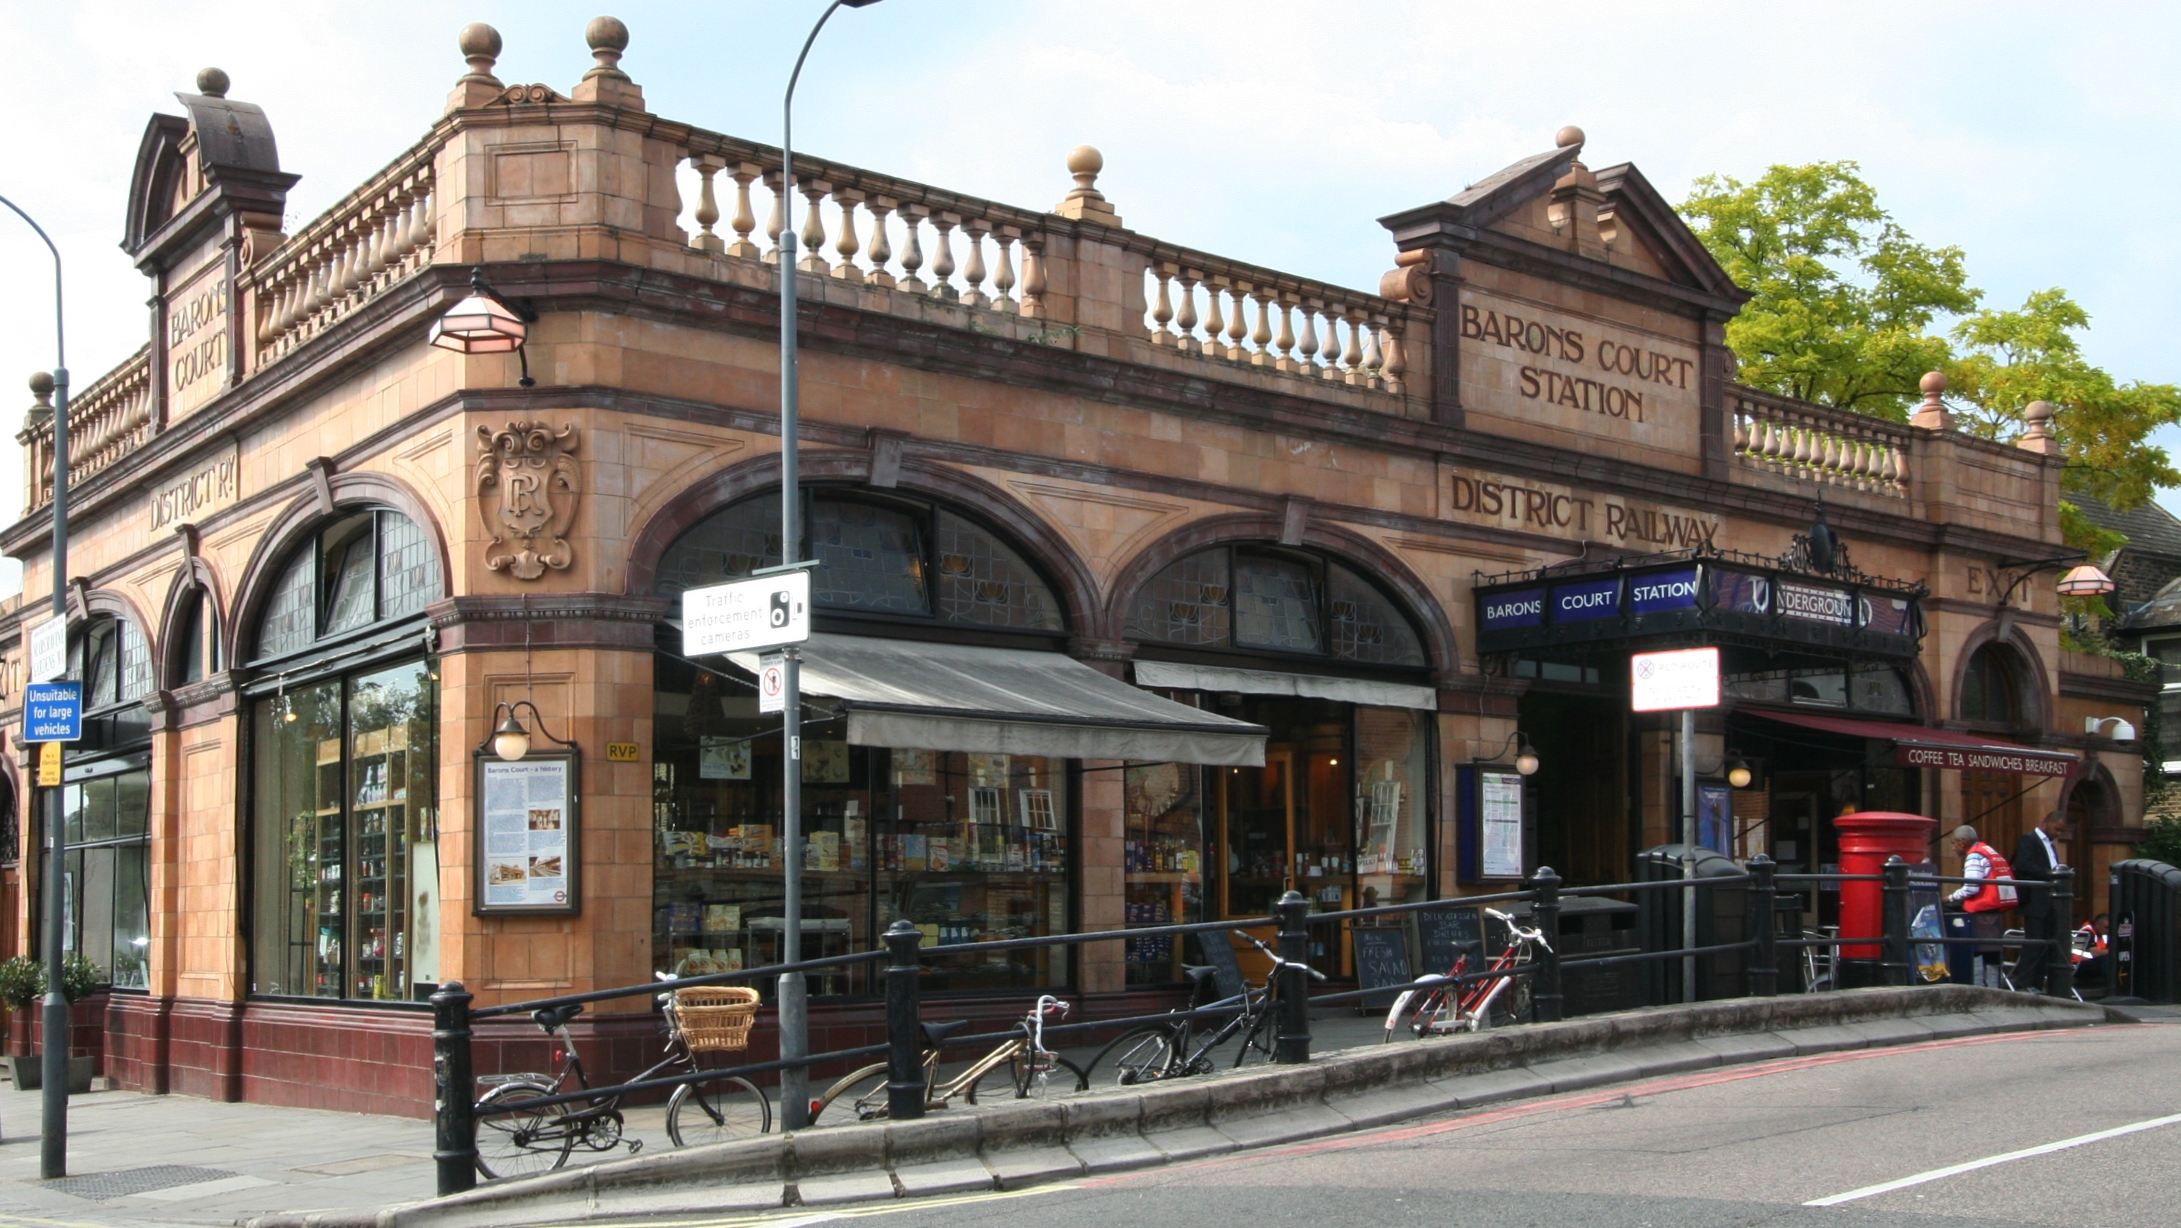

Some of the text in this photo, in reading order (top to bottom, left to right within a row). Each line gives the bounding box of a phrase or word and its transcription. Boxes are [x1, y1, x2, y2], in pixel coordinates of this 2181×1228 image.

[171, 280, 226, 349] BARONS
[1460, 303, 1693, 390] BARONS COURT
[175, 328, 227, 392] COURT
[1520, 365, 1643, 423] STATION
[150, 465, 216, 533] DISTRICT
[1451, 475, 1718, 548] DISTRICT RAILWAY
[1967, 565, 2032, 602] EXIT
[706, 591, 744, 608] Traffic
[1486, 581, 1696, 620] BARONS COURT STATION
[1751, 578, 1873, 627] UNDERGROUND
[688, 607, 763, 629] enforcement
[701, 629, 750, 646] cameras
[29, 688, 77, 702] Unsuitable
[33, 707, 72, 720] for large
[34, 723, 70, 736] vehicles
[609, 745, 637, 758] RVP
[1908, 749, 2068, 775] COFFEE TEA SANDWICHES BREAKFAST
[540, 766, 562, 774] history
[1363, 946, 1393, 959] FRESH
[1368, 959, 1408, 976] SALAD
